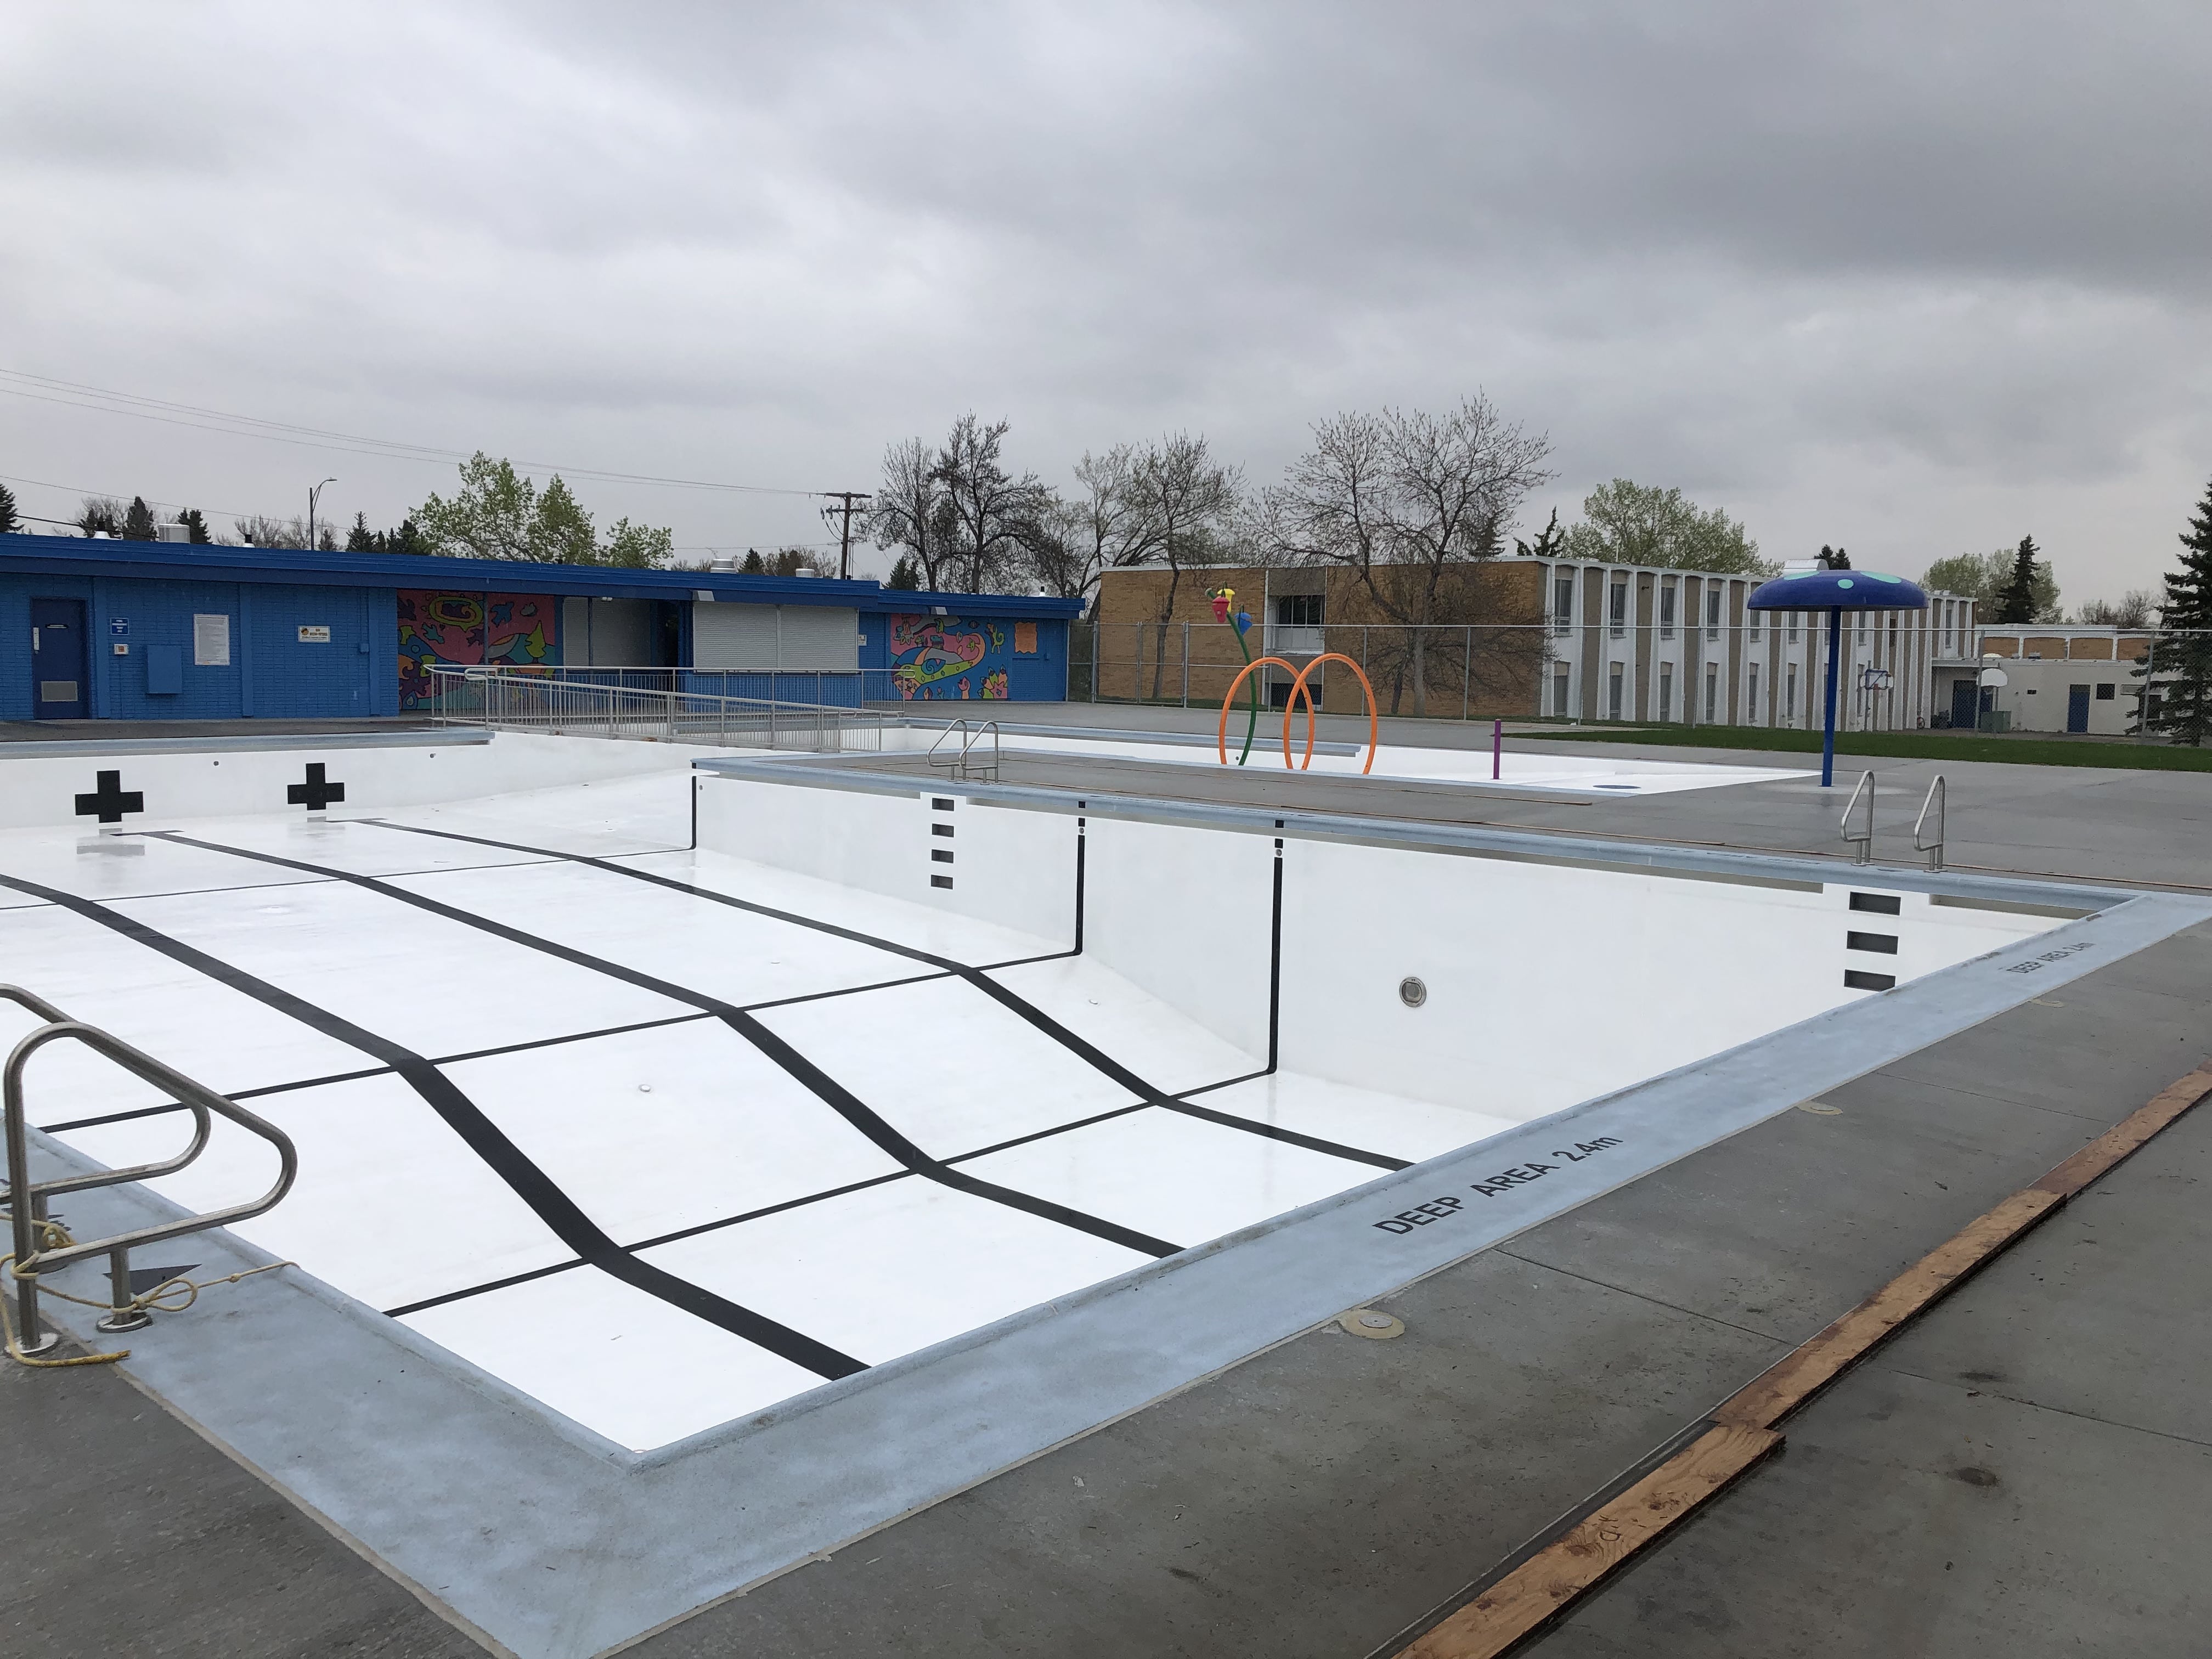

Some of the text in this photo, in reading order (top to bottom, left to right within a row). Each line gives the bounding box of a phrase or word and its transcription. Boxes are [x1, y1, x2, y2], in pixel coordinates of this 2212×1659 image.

[2006, 961, 2045, 973] DEEP
[2036, 951, 2075, 962] AREA
[1372, 1137, 1623, 1234] DEEP AREA 2.4m
